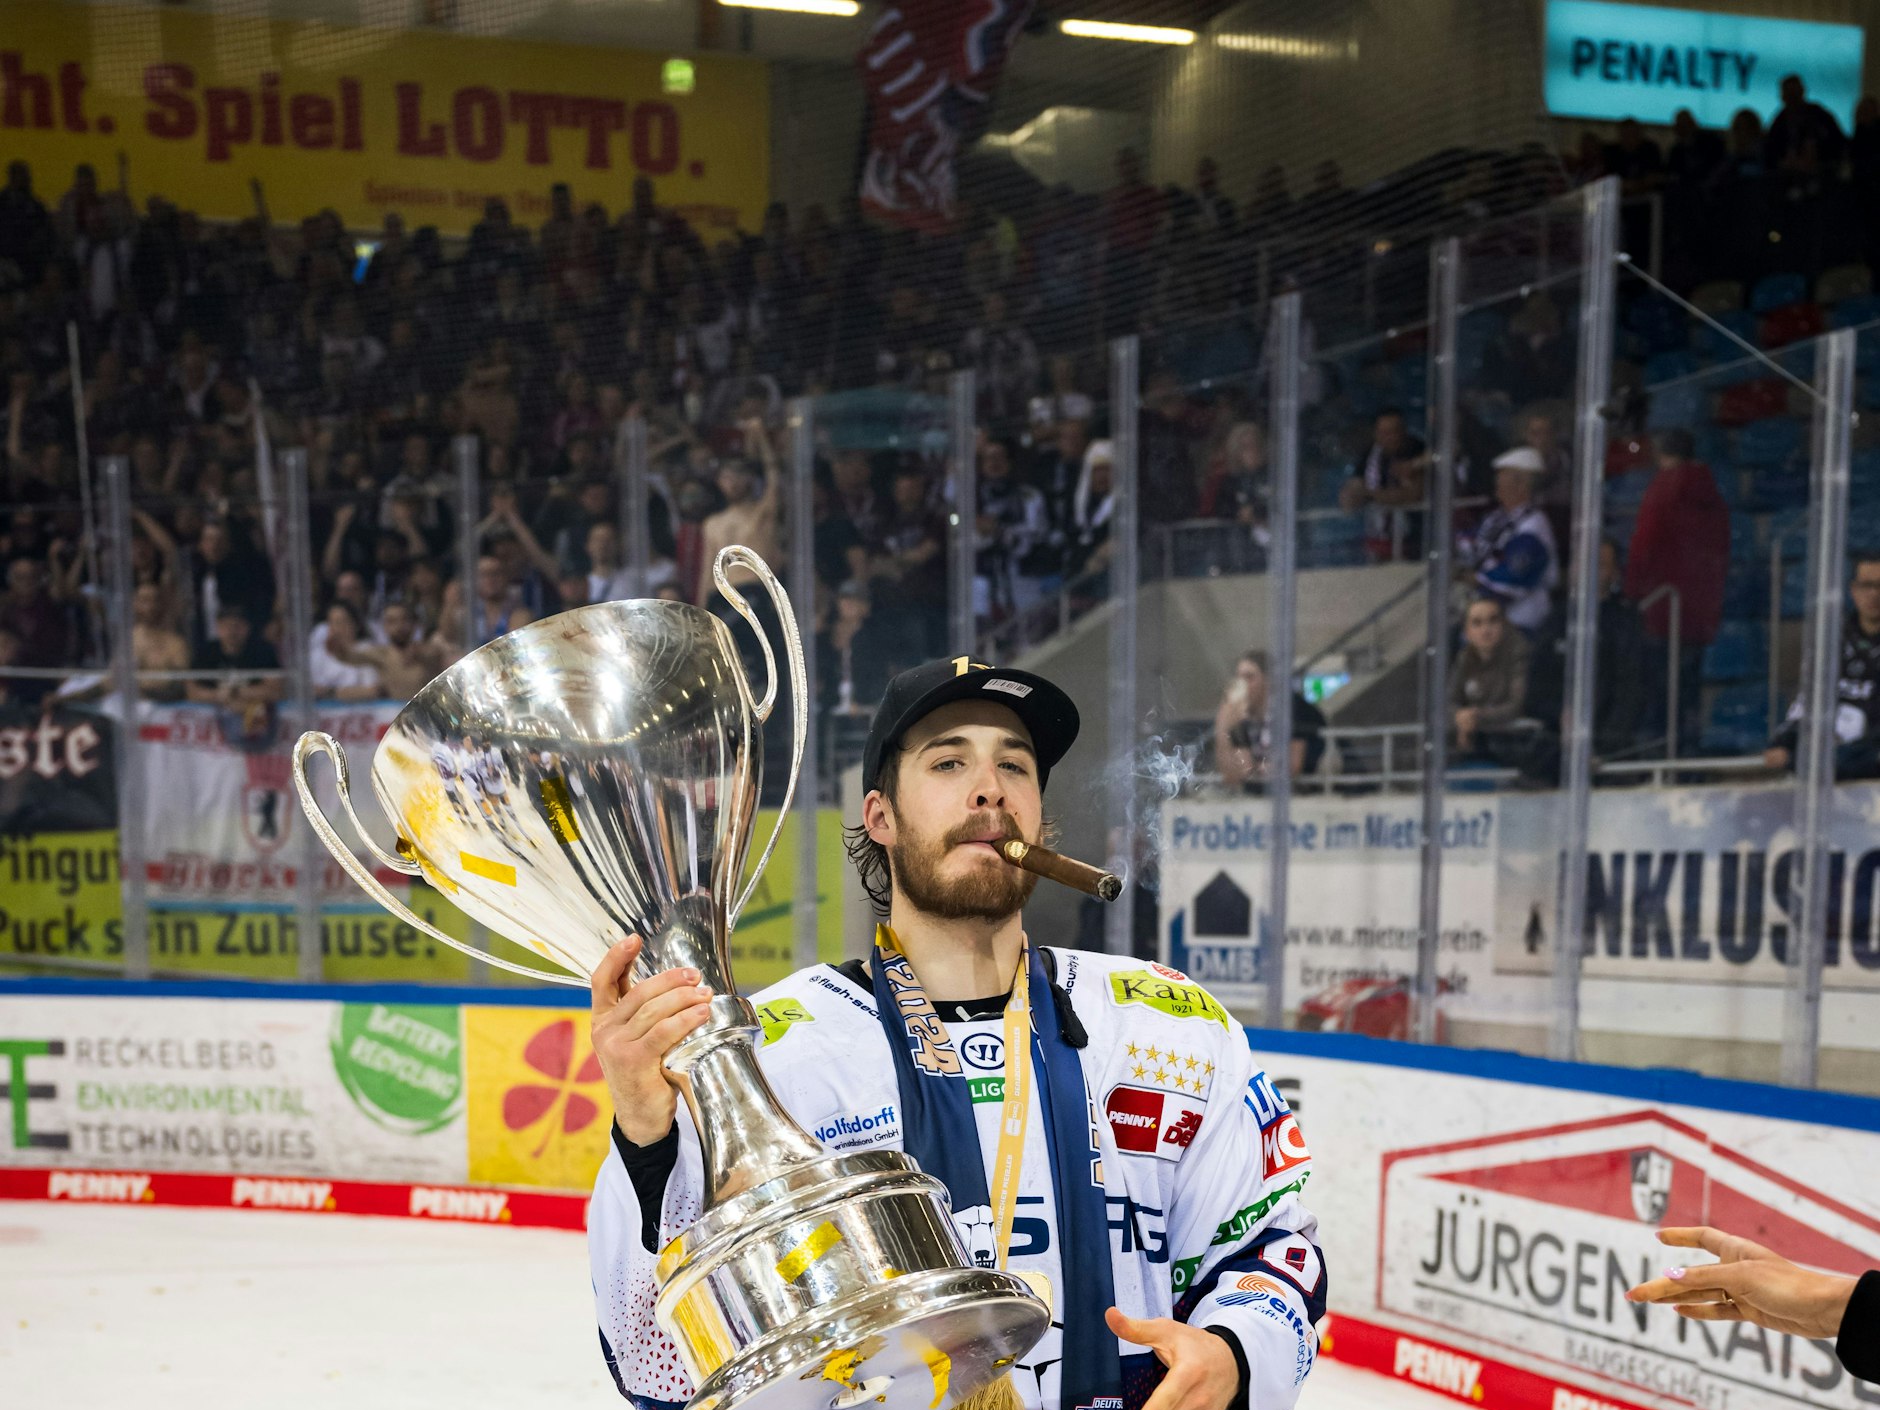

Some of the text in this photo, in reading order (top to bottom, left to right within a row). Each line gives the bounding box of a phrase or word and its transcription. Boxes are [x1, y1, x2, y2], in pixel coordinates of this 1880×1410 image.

[1570, 36, 1758, 91] PENALTY
[144, 63, 364, 161] Spiel
[395, 81, 706, 178] LOTTO.
[1173, 809, 1493, 850] Problee im Mietcht?
[0, 835, 120, 896] ingu
[1557, 847, 1880, 969] NKLUSIO
[104, 912, 199, 955] sin
[216, 909, 436, 957] Zuhuse!
[1192, 949, 1257, 981] DMB
[884, 960, 966, 1077] 2024
[1118, 978, 1226, 1023] Karls
[1171, 1004, 1193, 1014] 1921
[75, 1037, 277, 1070] RECKELBERG
[77, 1084, 309, 1117] ENVIRONMENTAL
[971, 1081, 1006, 1098] LIG
[77, 1123, 316, 1160] TECHNOLOGIES
[875, 1129, 899, 1142] GmbH
[1420, 1194, 1650, 1335] JÜRGEN
[1094, 1400, 1123, 1409] DEUTS
